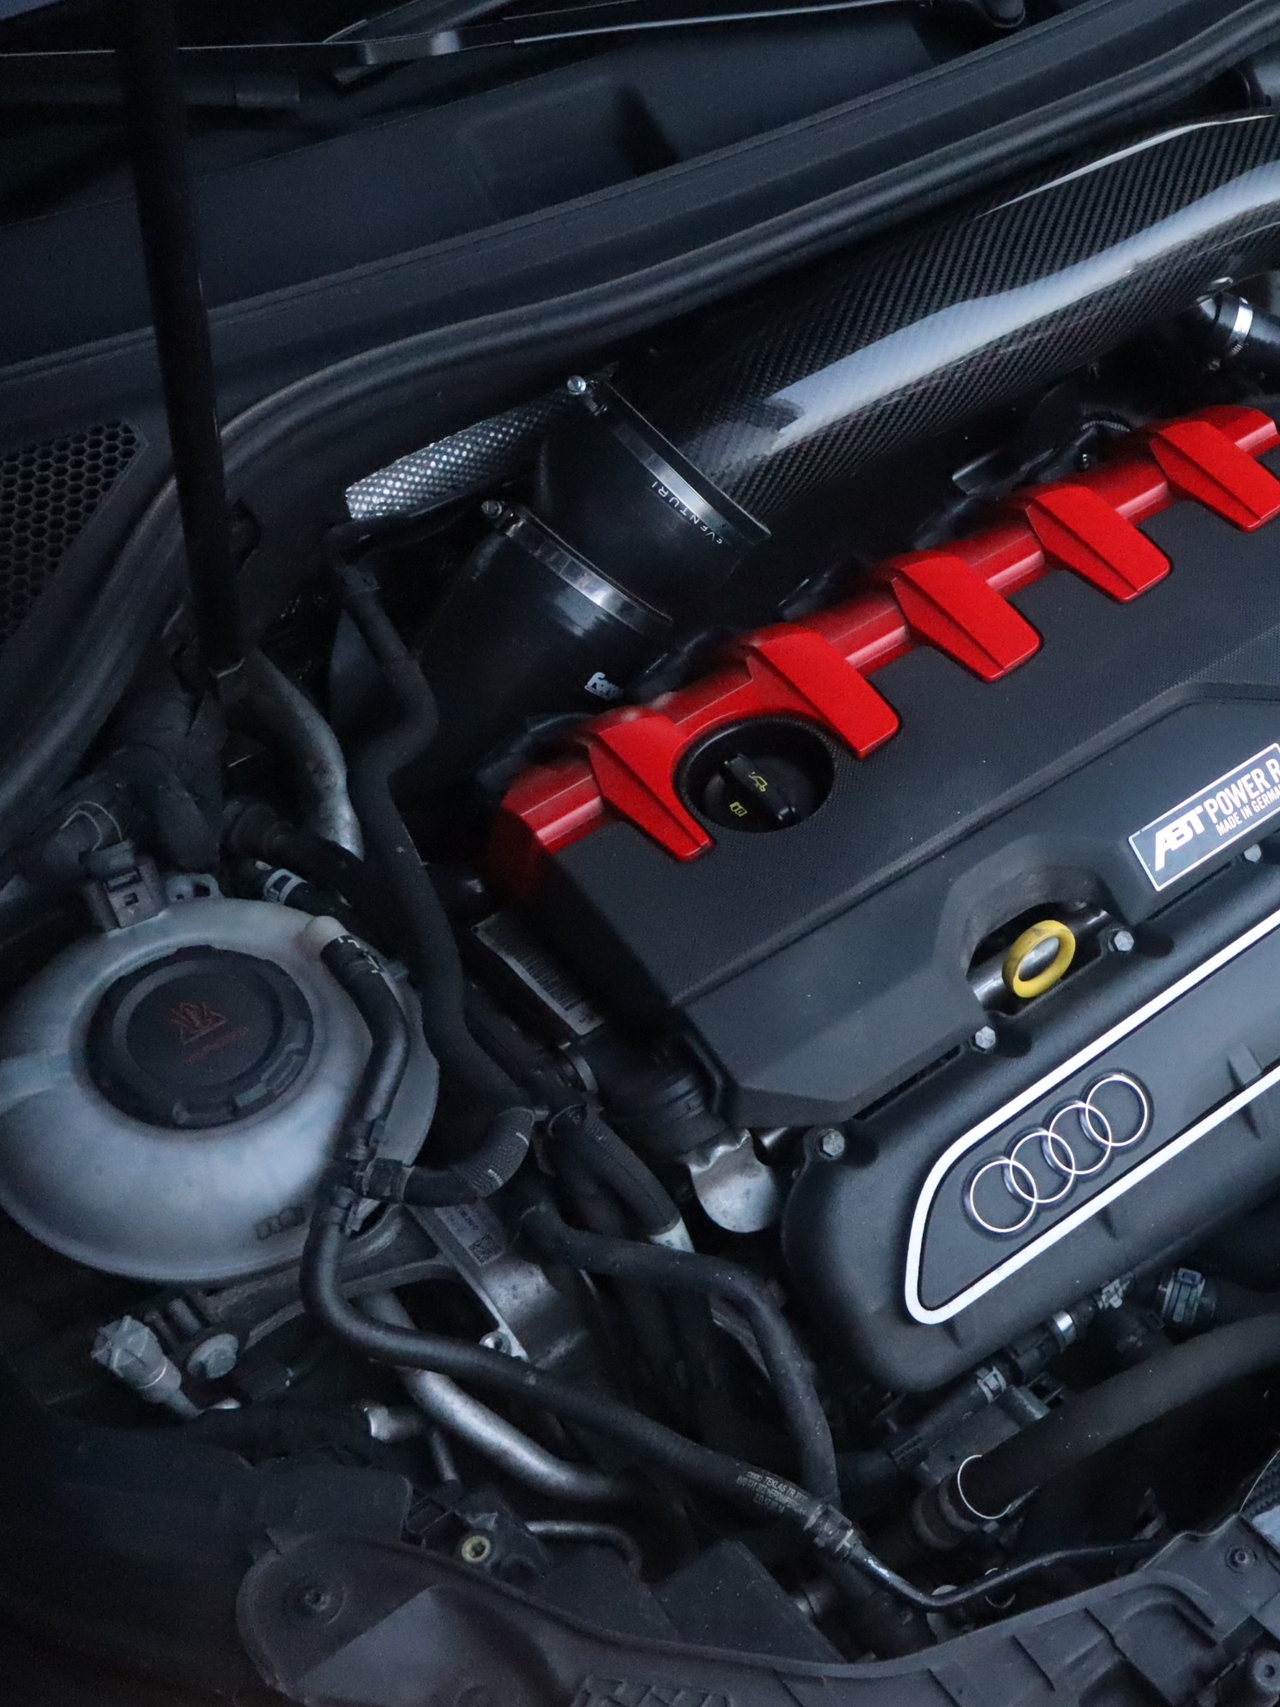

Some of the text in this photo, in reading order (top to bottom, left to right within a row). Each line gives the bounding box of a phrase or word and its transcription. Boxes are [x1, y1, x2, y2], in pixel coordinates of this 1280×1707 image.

[1154, 804, 1206, 872] ABT
[1203, 767, 1271, 824] POWER
[1215, 812, 1243, 837] MADE
[1240, 804, 1254, 821] IN
